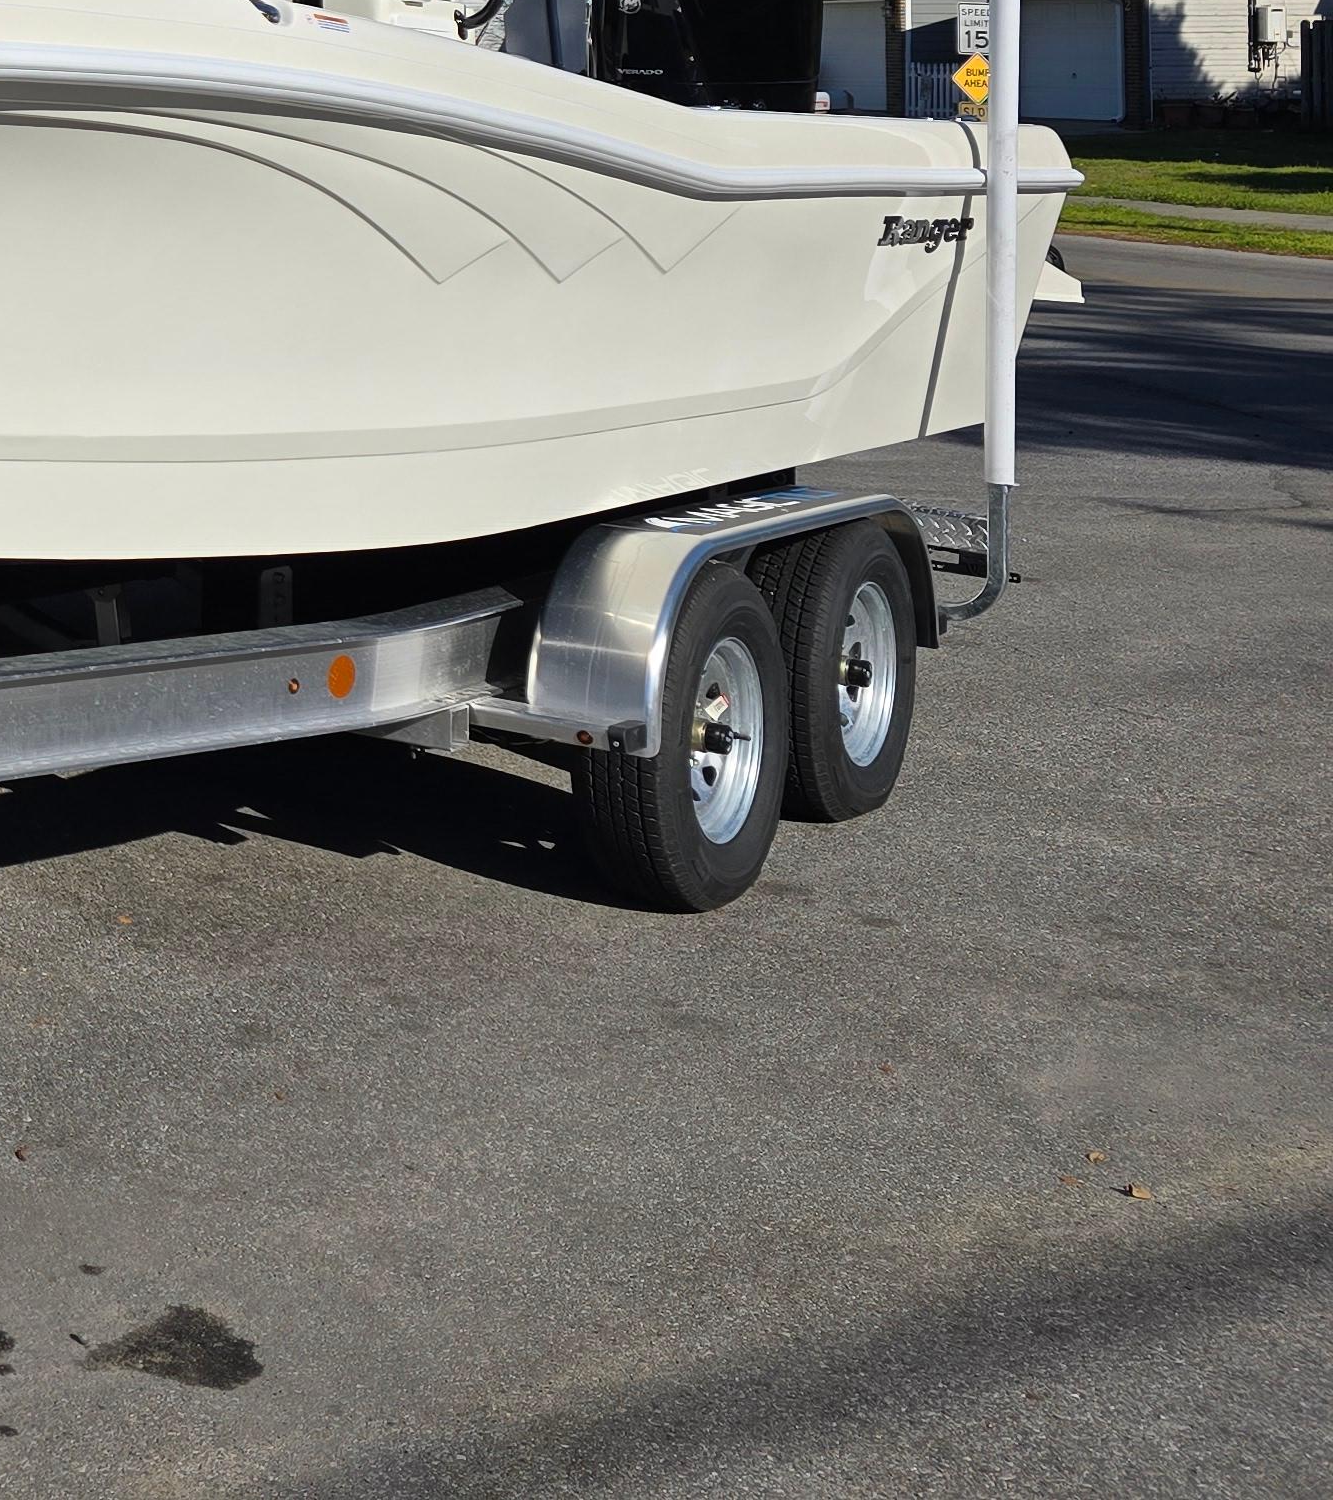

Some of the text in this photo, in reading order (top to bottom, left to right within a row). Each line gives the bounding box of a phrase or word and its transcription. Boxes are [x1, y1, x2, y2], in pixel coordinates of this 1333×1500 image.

[964, 19, 989, 27] LIMIT
[965, 30, 989, 49] 15
[964, 79, 988, 88] AHEA
[963, 107, 989, 118] SLO
[877, 215, 975, 253] Ranger
